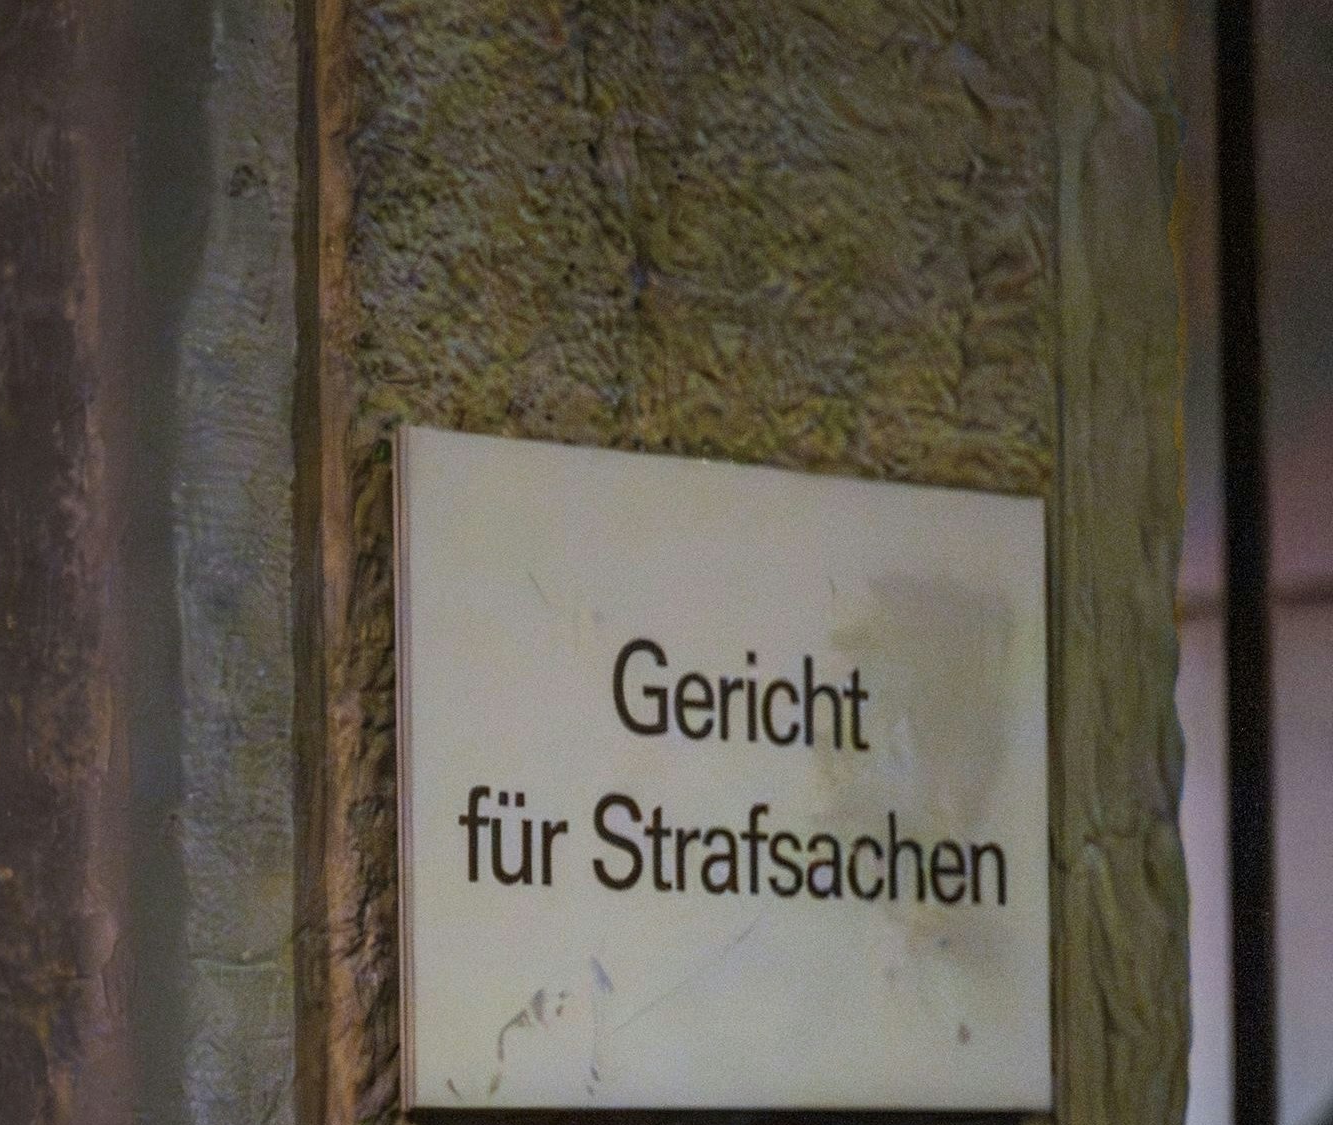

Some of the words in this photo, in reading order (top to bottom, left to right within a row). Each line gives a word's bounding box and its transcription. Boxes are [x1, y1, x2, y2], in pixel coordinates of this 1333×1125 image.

[612, 638, 869, 751] Gericht
[458, 785, 568, 886] für
[592, 793, 1007, 906] Strafsachen
